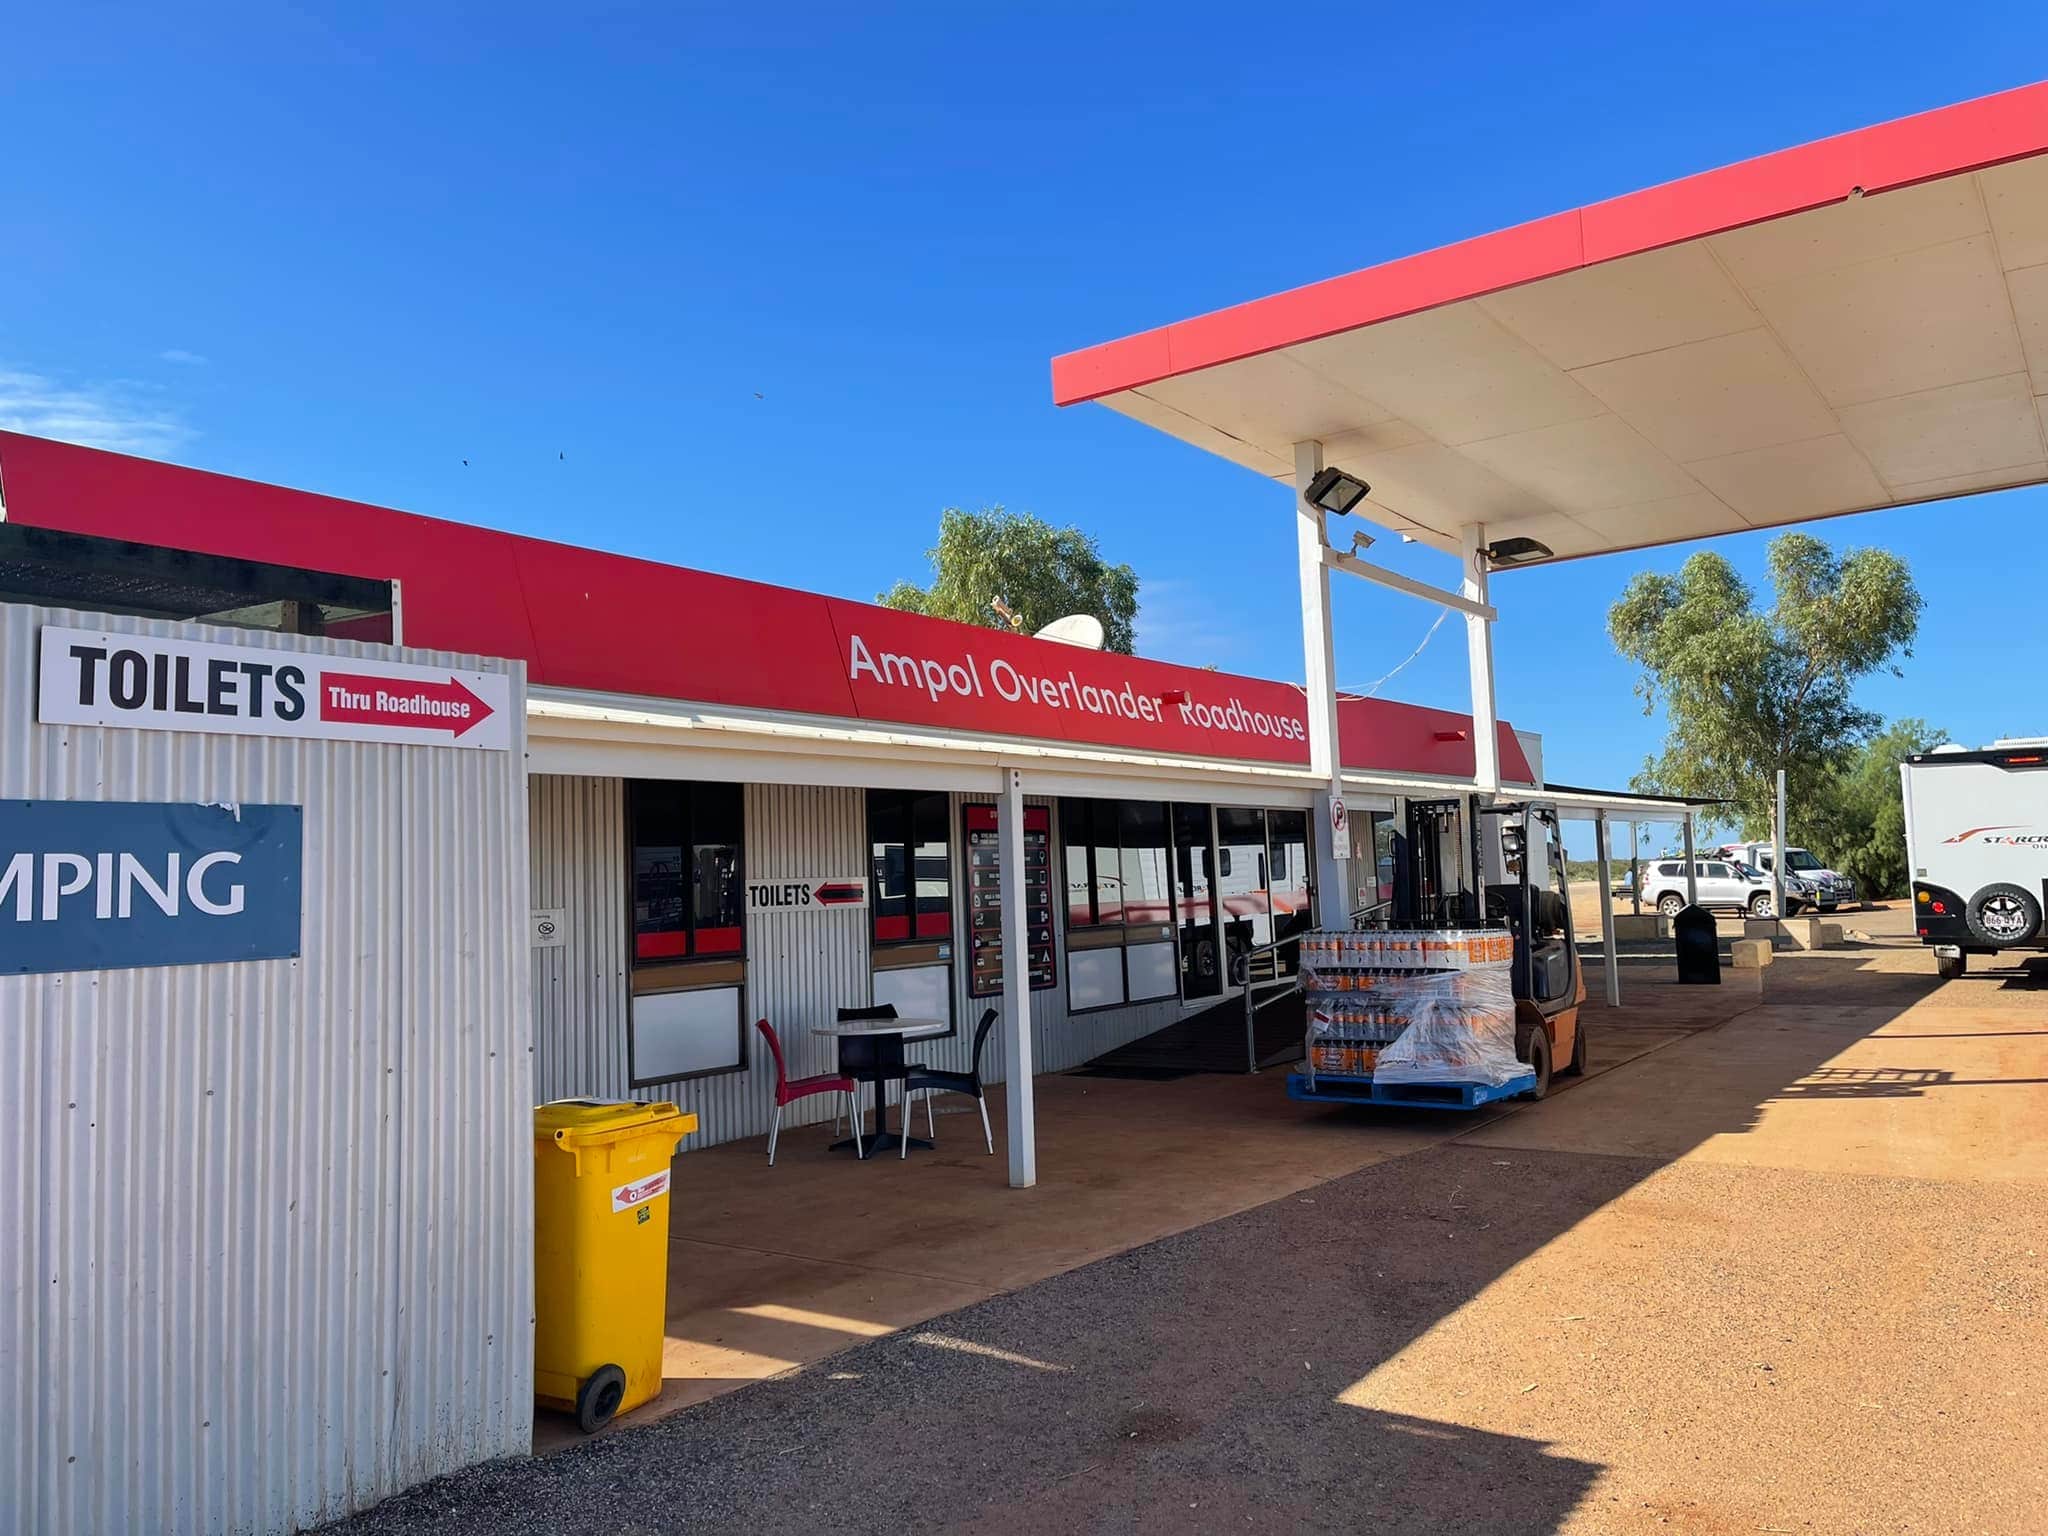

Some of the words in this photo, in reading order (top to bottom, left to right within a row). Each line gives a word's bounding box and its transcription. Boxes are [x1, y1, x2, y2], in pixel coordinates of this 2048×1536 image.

[69, 644, 306, 722] TOILETS
[328, 686, 371, 711] Thru
[376, 690, 471, 719] Roadhouse
[850, 634, 983, 702] Ampol
[990, 659, 1164, 723] Overlander
[1178, 697, 1305, 741] Roadhouse
[749, 884, 810, 907] TOILETS
